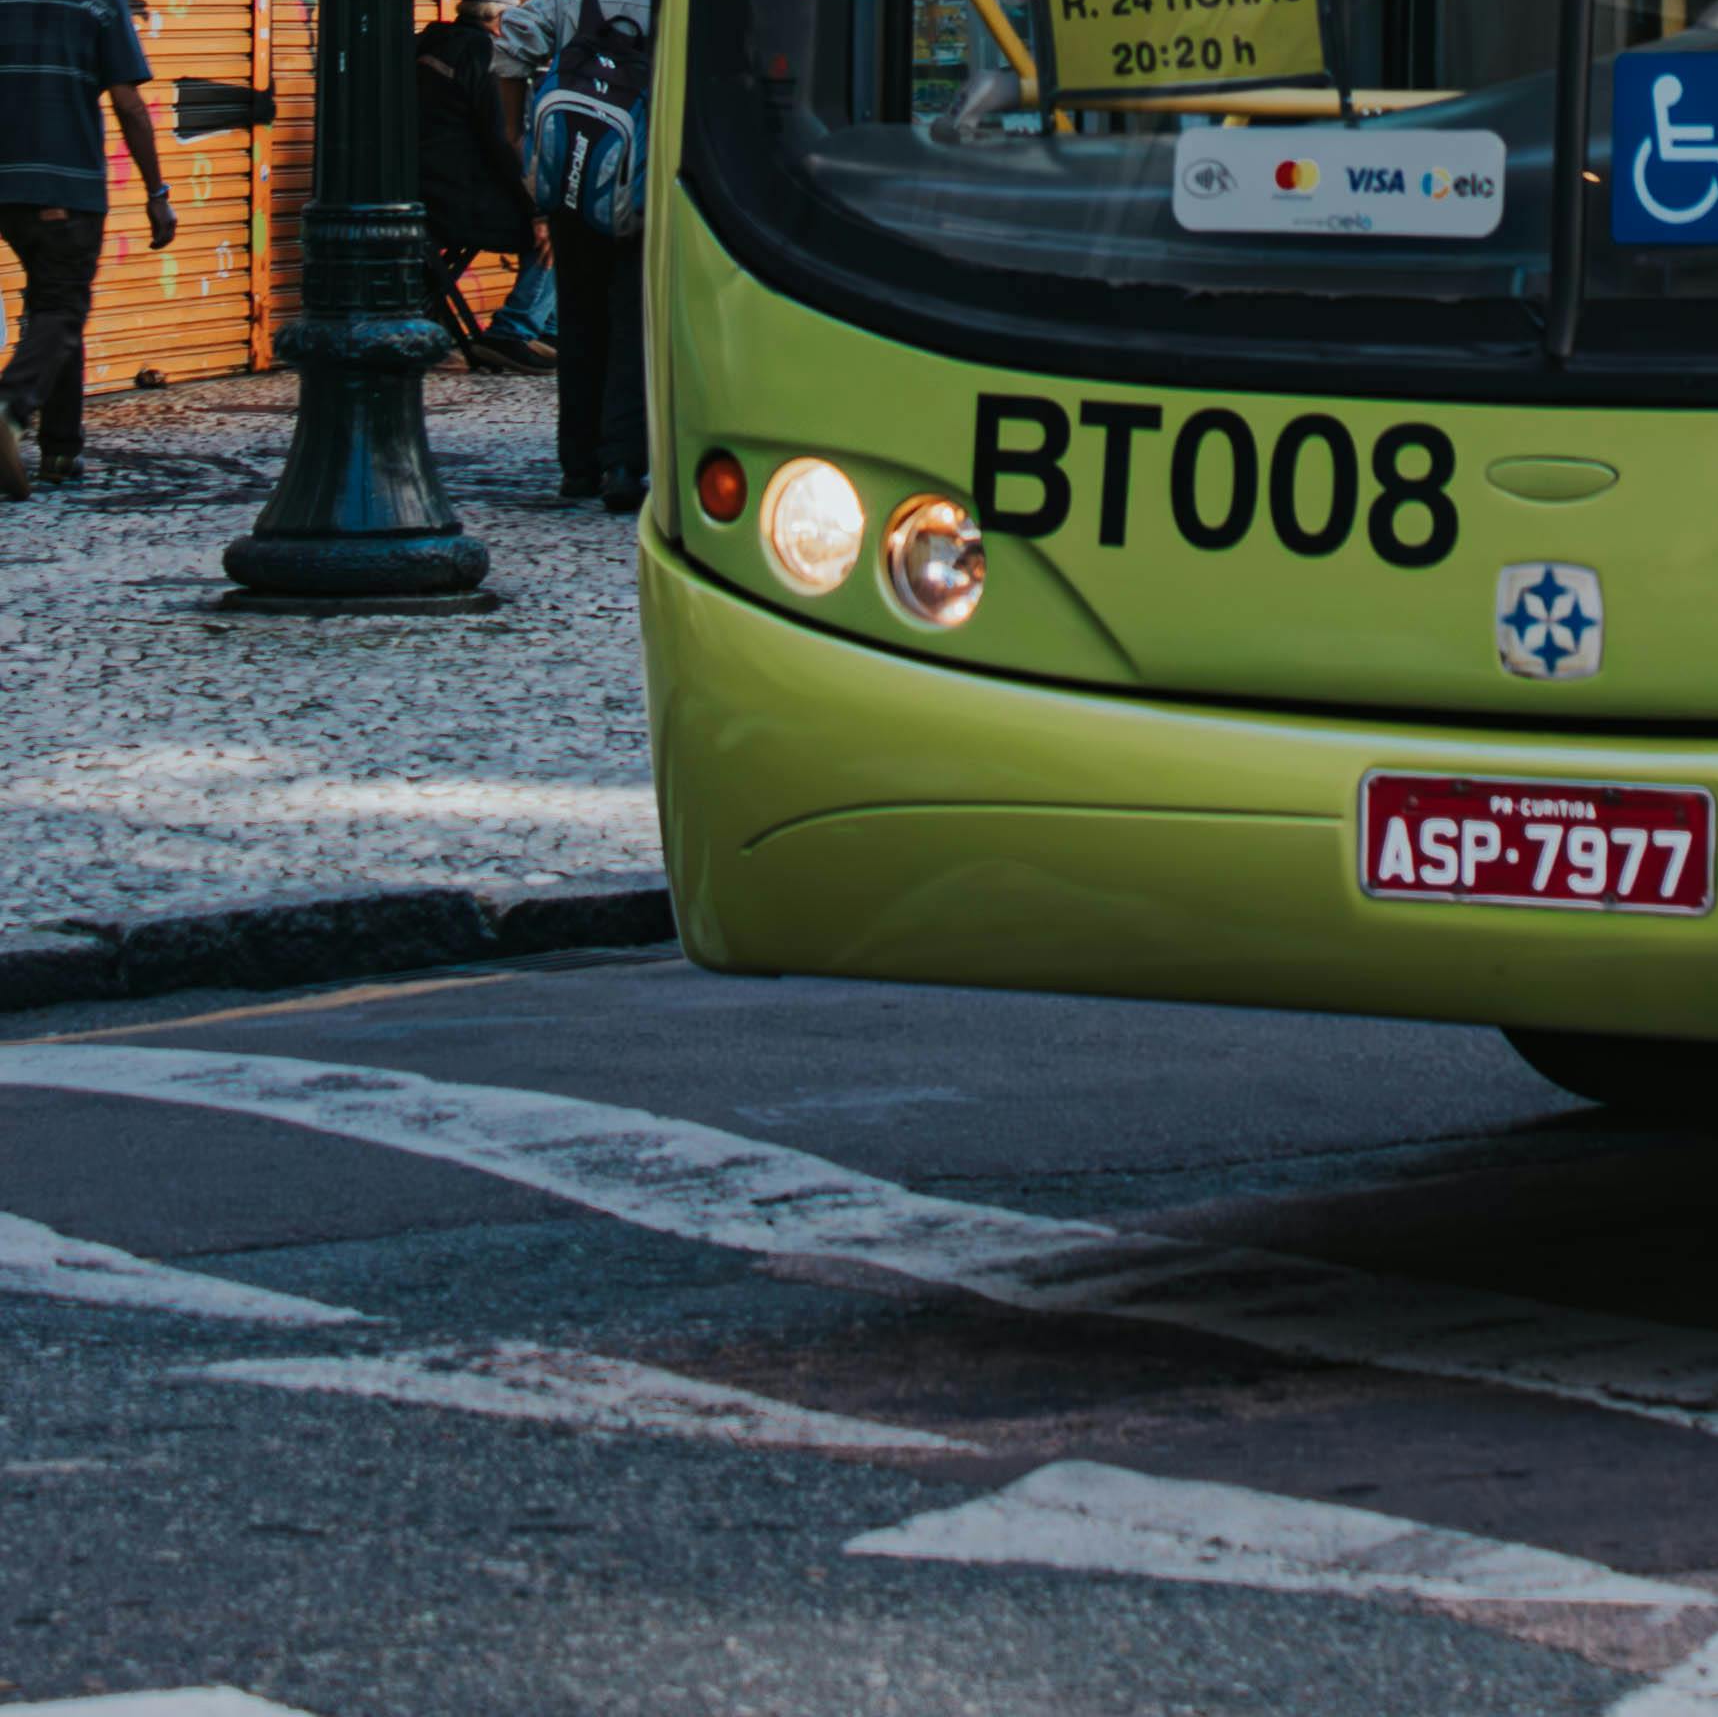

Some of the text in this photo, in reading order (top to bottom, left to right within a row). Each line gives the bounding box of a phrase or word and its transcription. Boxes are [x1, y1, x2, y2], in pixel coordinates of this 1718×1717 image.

[1112, 34, 1256, 76] 20:20 h
[1346, 167, 1405, 194] VISA
[972, 392, 1460, 569] BT008
